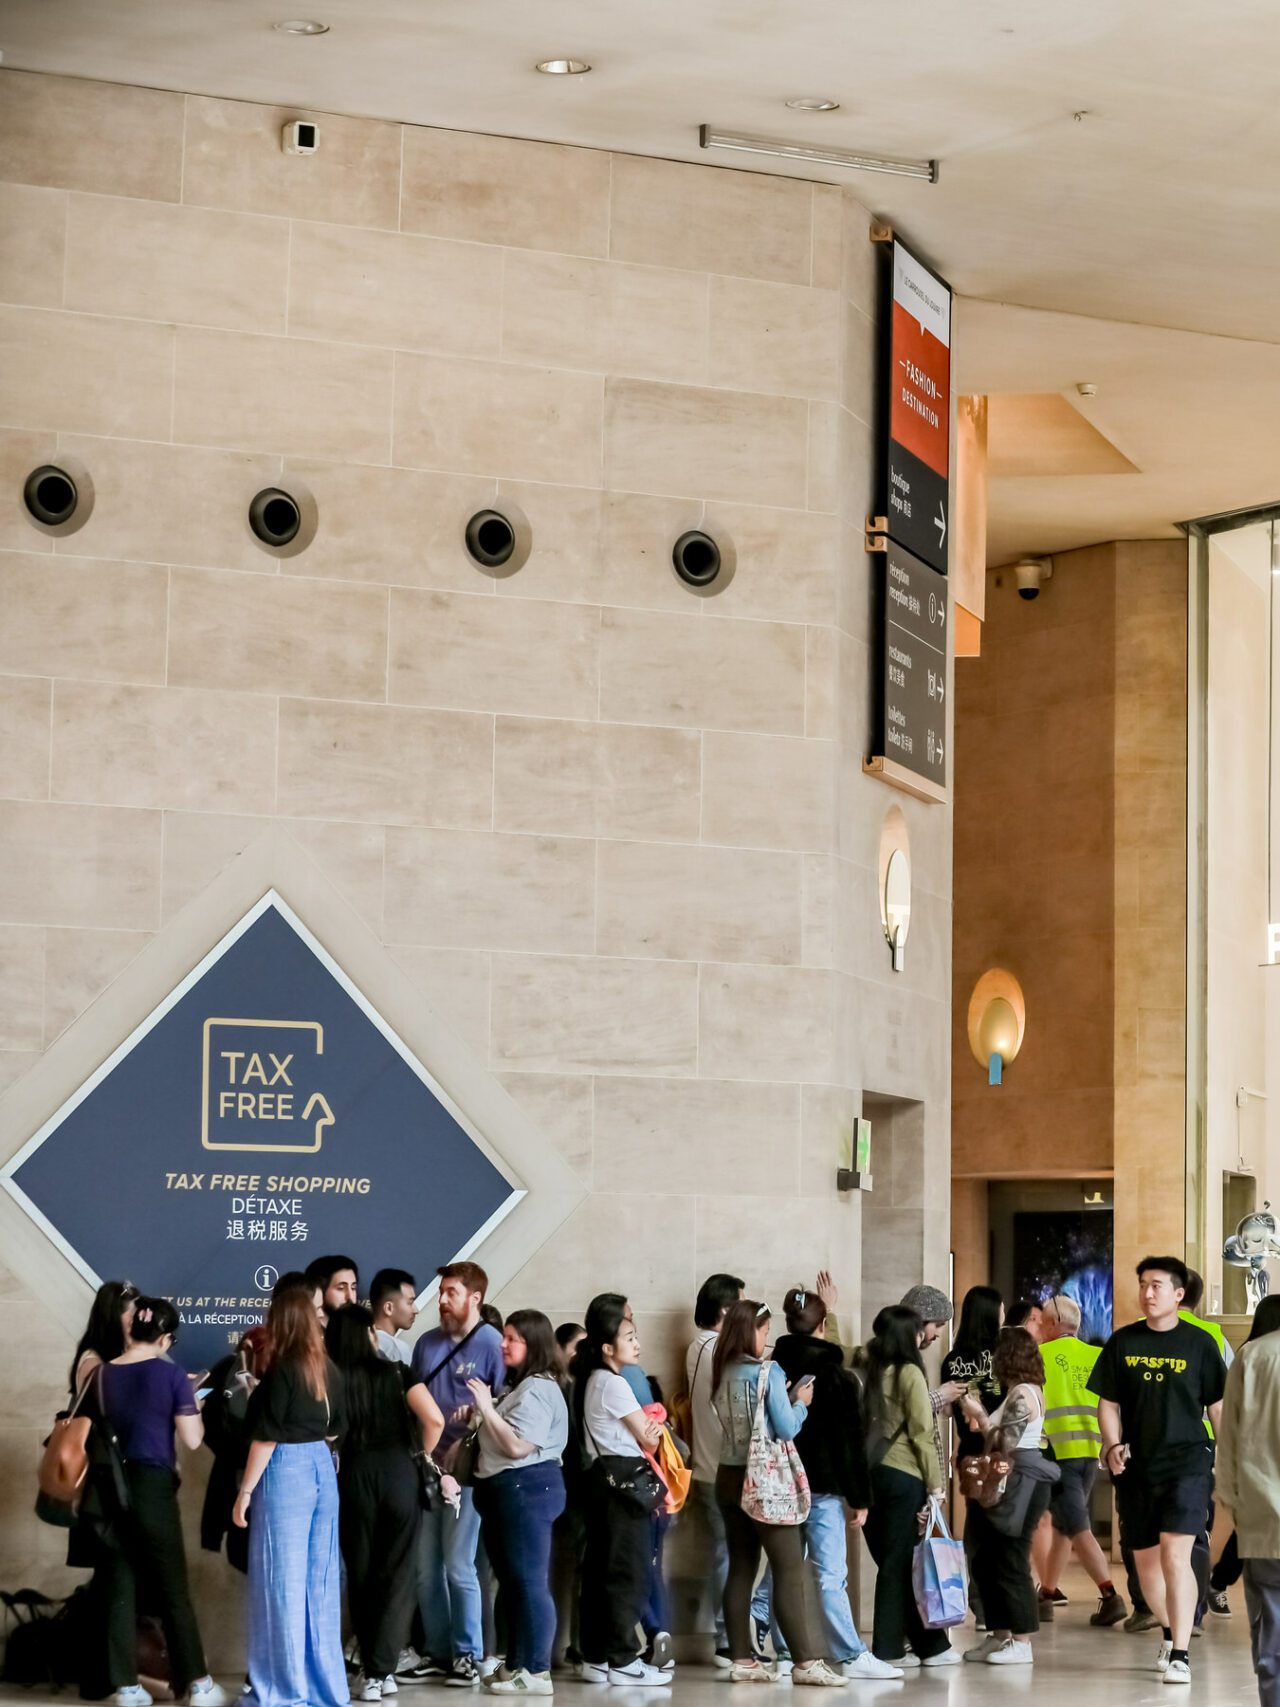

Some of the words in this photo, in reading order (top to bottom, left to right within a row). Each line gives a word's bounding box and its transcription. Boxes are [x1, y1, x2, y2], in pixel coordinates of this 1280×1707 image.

[906, 360, 937, 400] FASHION
[902, 387, 939, 429] DESTINATION
[220, 1051, 295, 1087] TAX
[219, 1091, 294, 1120] FREE
[165, 1173, 205, 1190] TAX
[209, 1173, 261, 1192] FREE
[266, 1175, 371, 1195] SHOPPING
[232, 1194, 303, 1216] DÉTAXE
[226, 1219, 310, 1242] 退税服务
[176, 1296, 193, 1307] US
[195, 1296, 211, 1307] AT
[214, 1297, 237, 1308] THE
[188, 1313, 202, 1324] LA
[204, 1311, 263, 1325] RÉCEPTION
